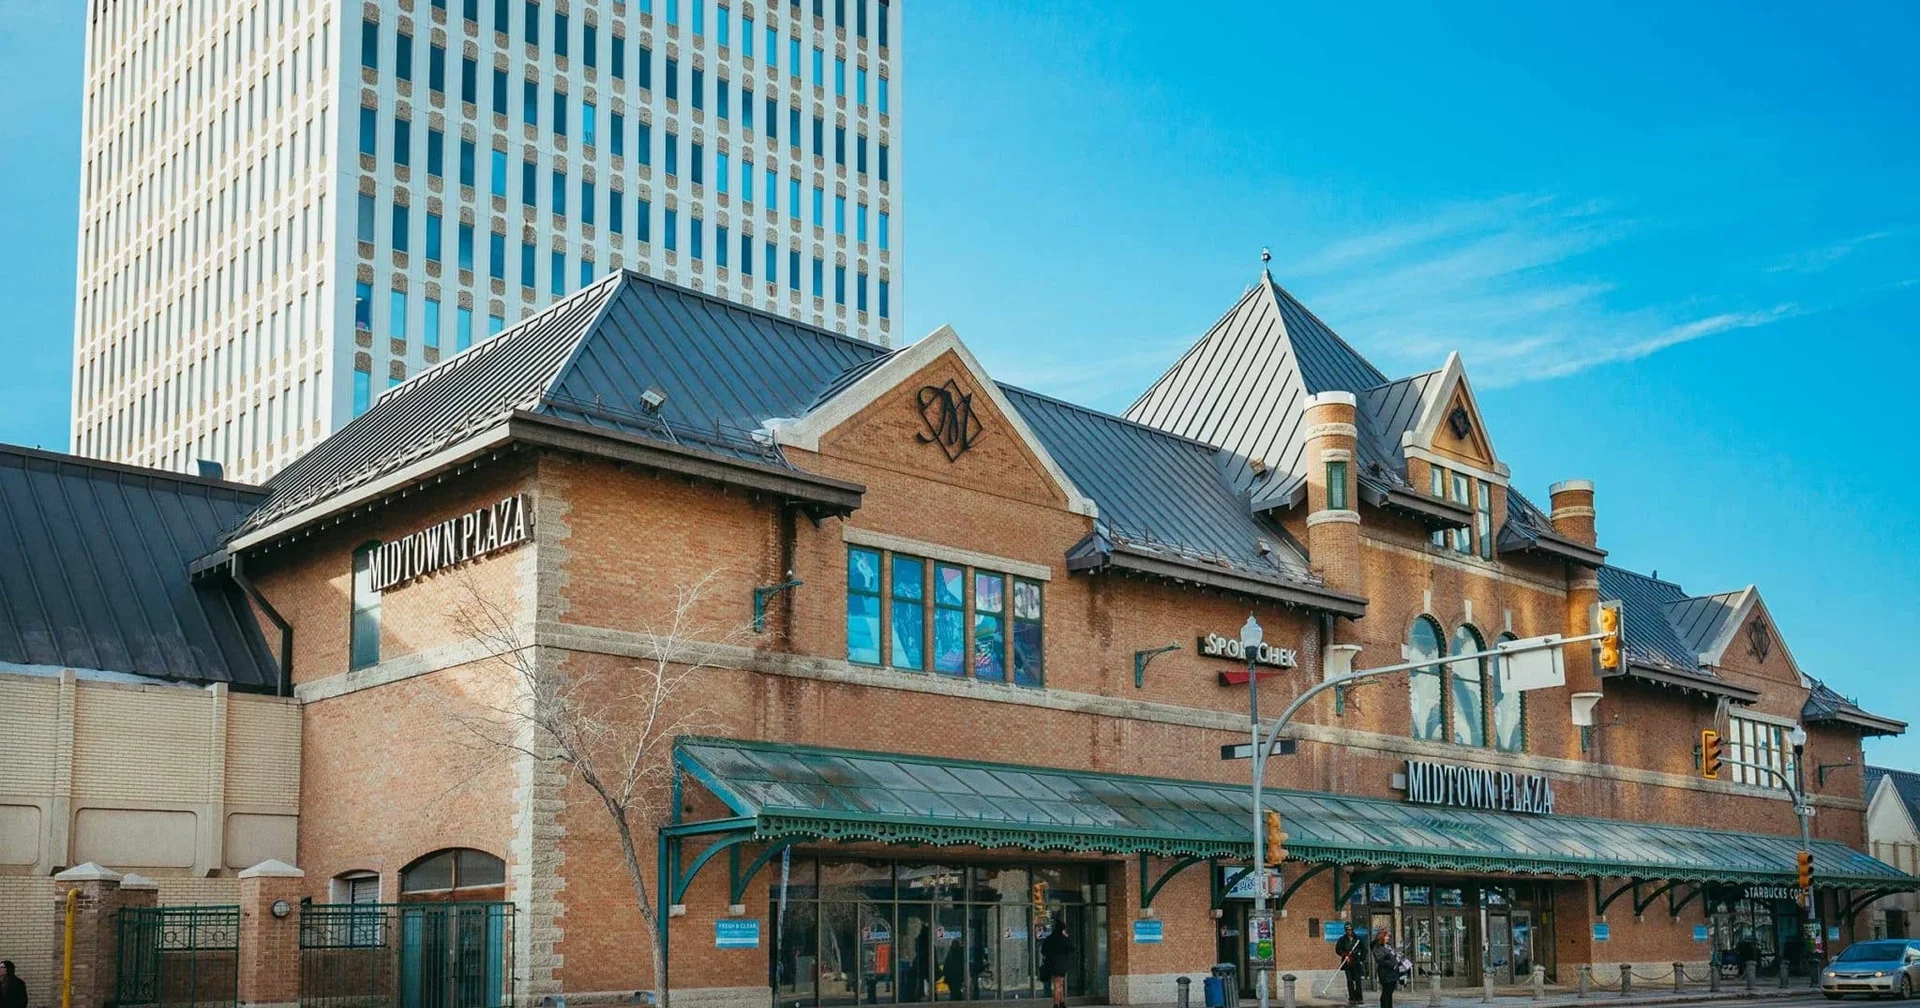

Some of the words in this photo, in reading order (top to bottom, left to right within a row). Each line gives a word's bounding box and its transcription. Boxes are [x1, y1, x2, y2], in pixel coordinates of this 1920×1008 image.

[368, 518, 458, 592] MIDTOWN
[462, 493, 527, 562] PLAZA
[1258, 641, 1299, 668] CHEK
[1408, 760, 1497, 809] MIDTOWN
[1500, 771, 1553, 815] PLAZA
[1744, 886, 1788, 899] STARBUCKS
